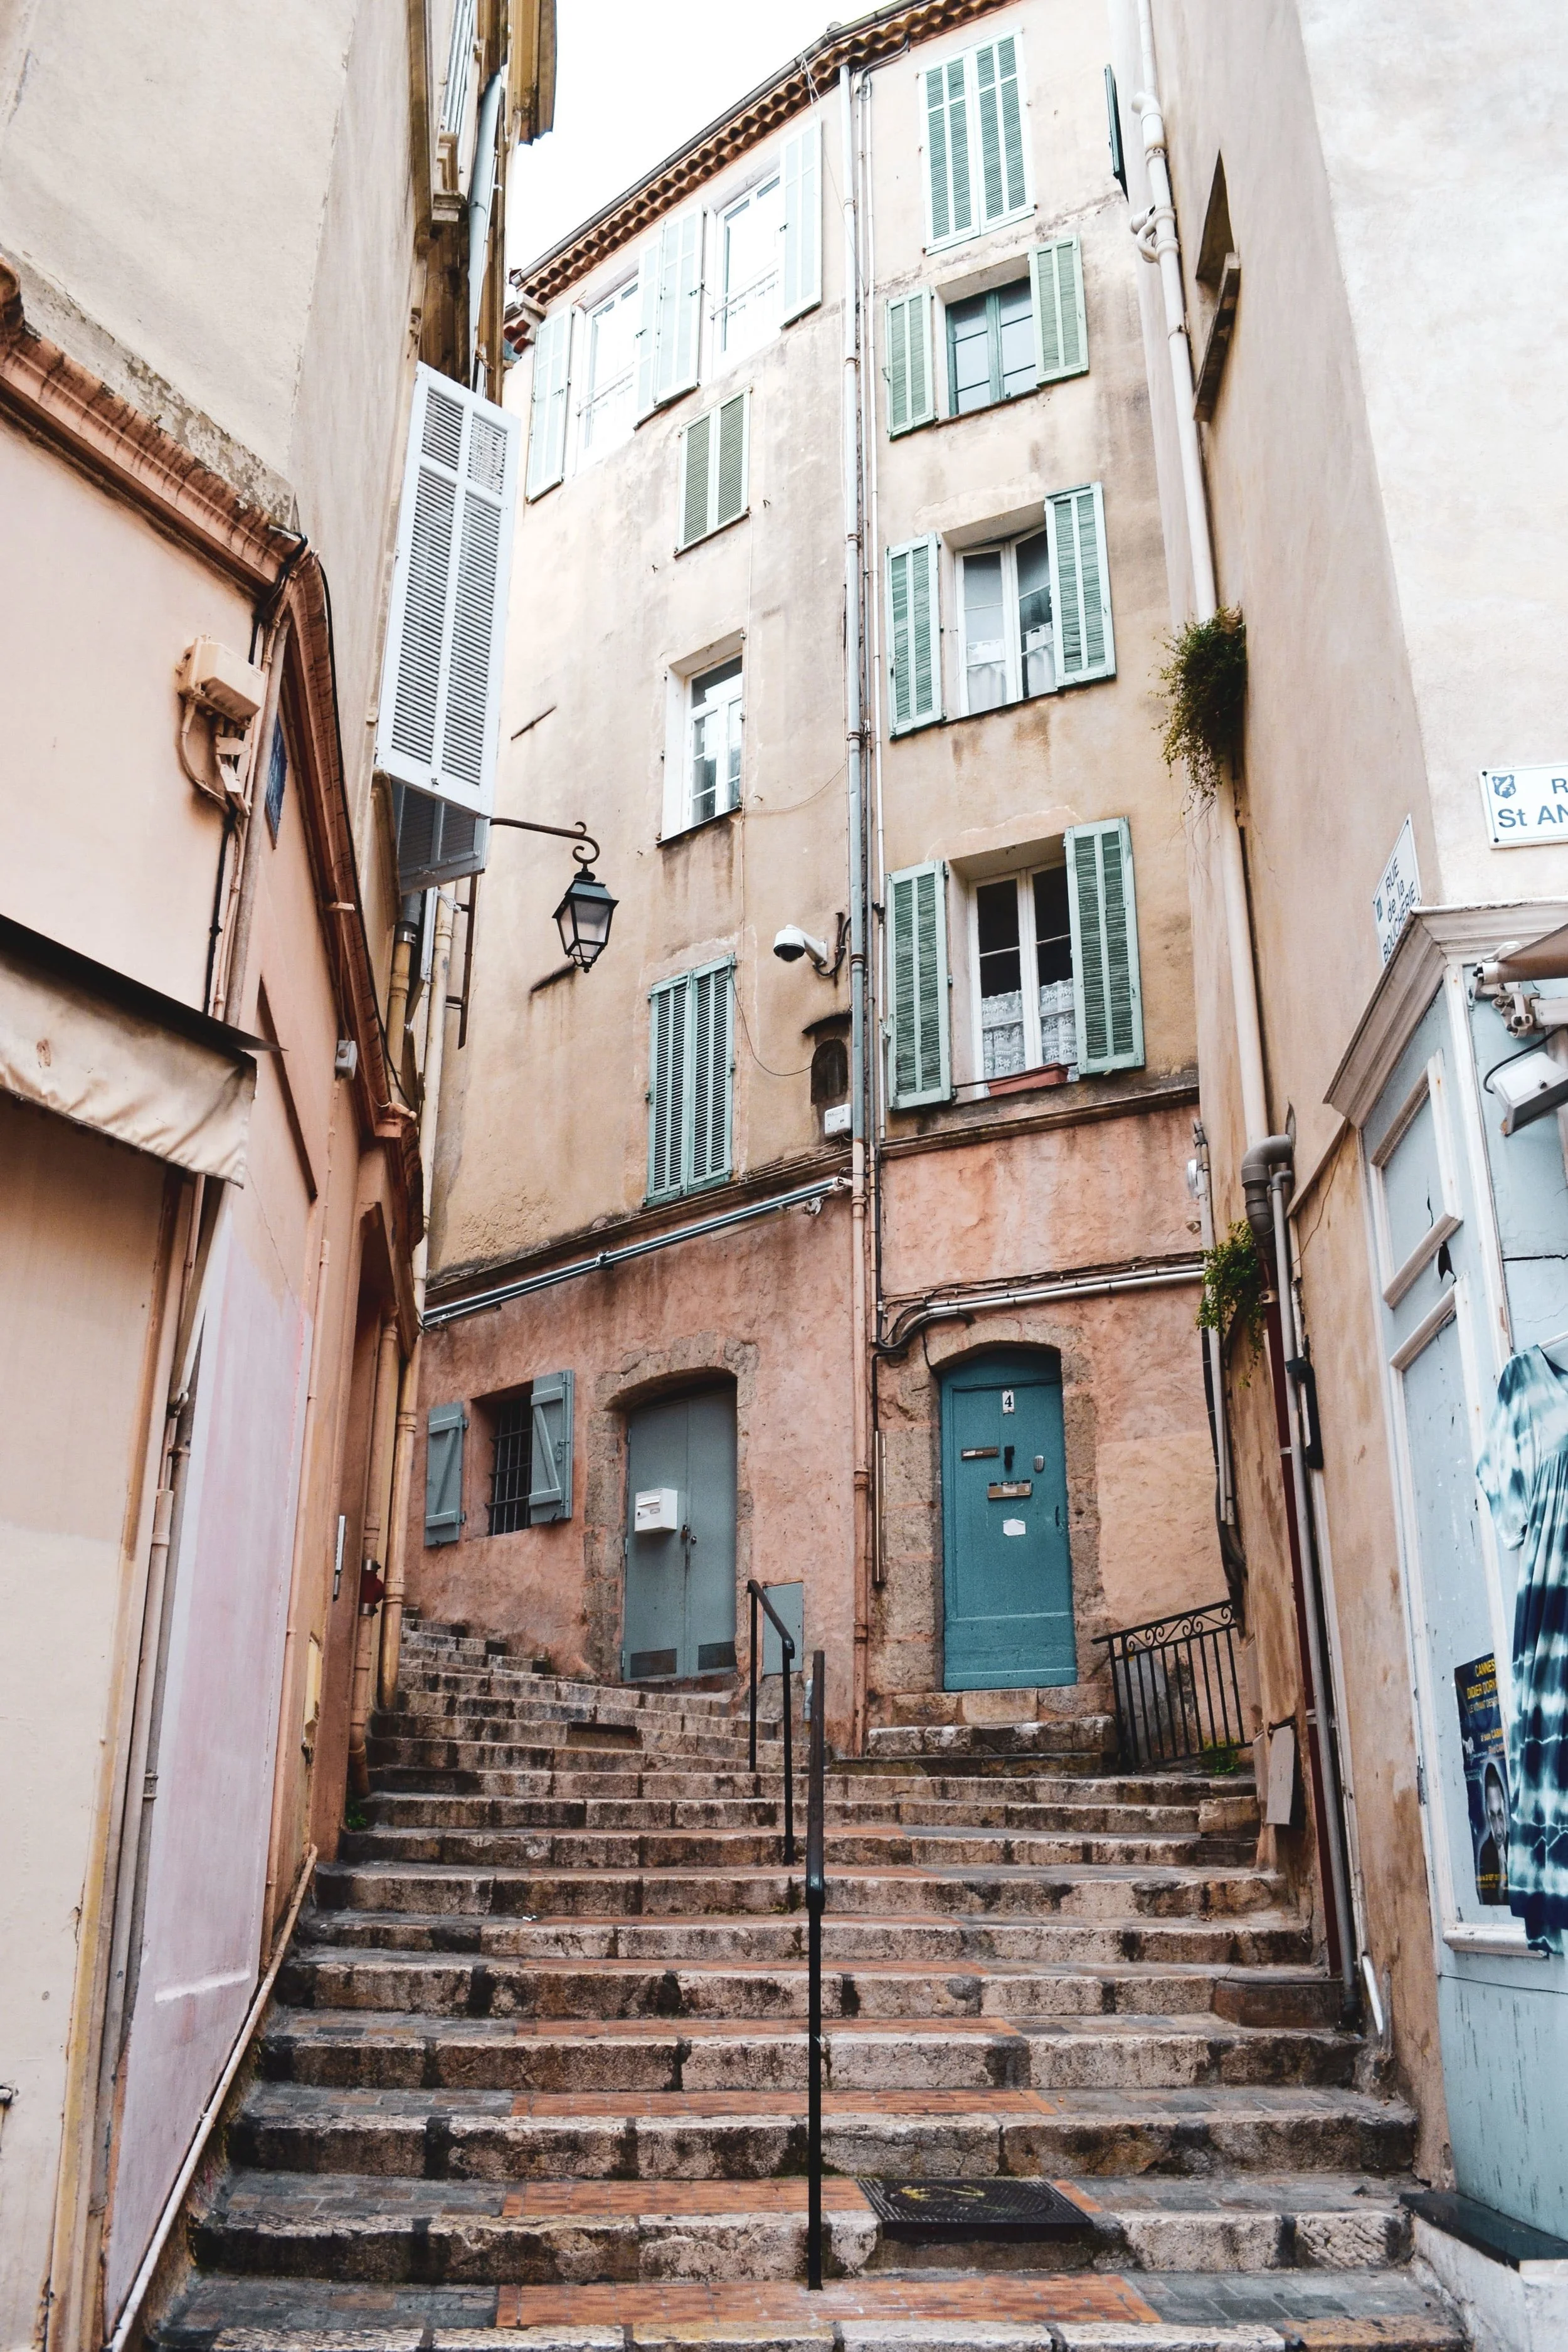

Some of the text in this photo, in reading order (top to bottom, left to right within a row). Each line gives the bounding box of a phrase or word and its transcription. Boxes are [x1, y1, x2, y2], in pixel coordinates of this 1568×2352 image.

[1498, 808, 1527, 828] St
[1385, 857, 1399, 896] RUE
[1387, 879, 1404, 923] de la
[1383, 881, 1416, 962] BOUCHERIE
[1005, 1395, 1012, 1407] 4
[1475, 1658, 1495, 1678] CANNES
[1467, 1683, 1482, 1700] DIDIER
